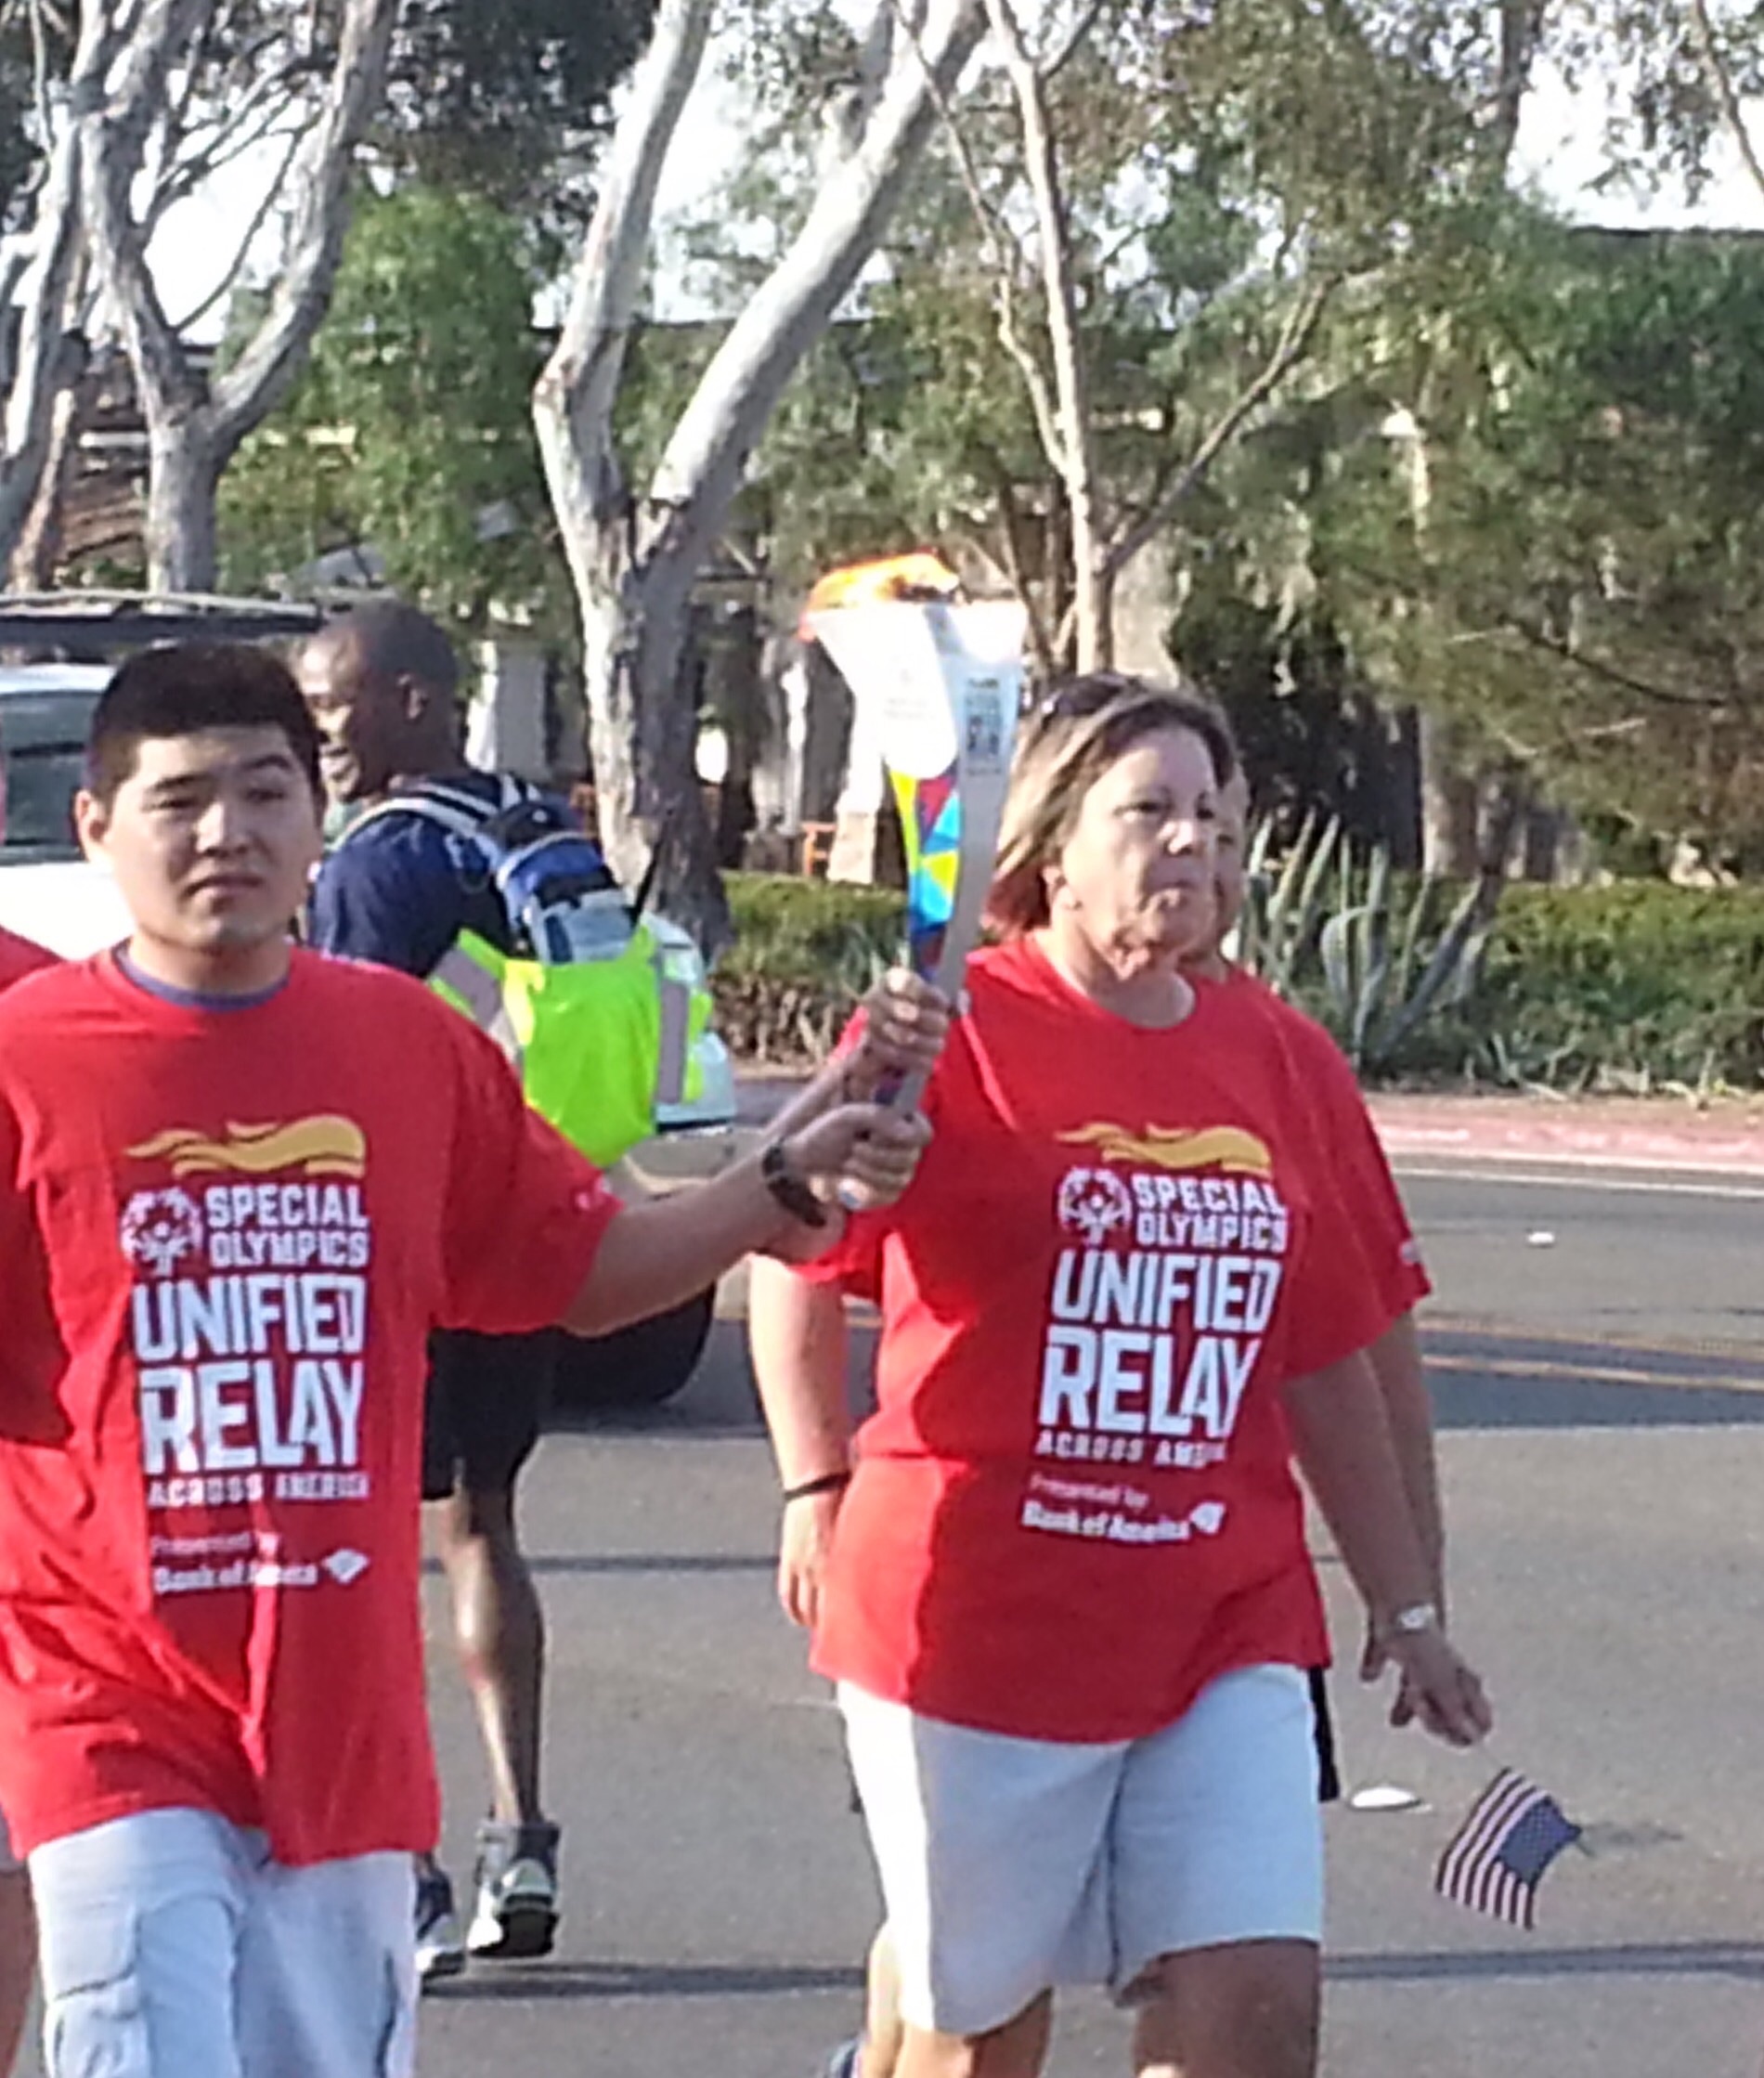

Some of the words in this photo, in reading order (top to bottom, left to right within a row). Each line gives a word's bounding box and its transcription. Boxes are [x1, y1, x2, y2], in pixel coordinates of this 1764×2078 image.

[205, 1185, 369, 1227] SPECIAL
[1131, 1173, 1287, 1214] SPECIAL
[209, 1230, 370, 1267] OLYMPICS
[1136, 1212, 1288, 1253] OLYMPICS
[1051, 1248, 1282, 1332] UNIFIED
[133, 1273, 366, 1361] UNIFIED
[1039, 1324, 1261, 1438] RELAY
[140, 1359, 363, 1474] RELAY
[1035, 1429, 1144, 1462] ACROSS
[148, 1474, 263, 1508] ACROSS
